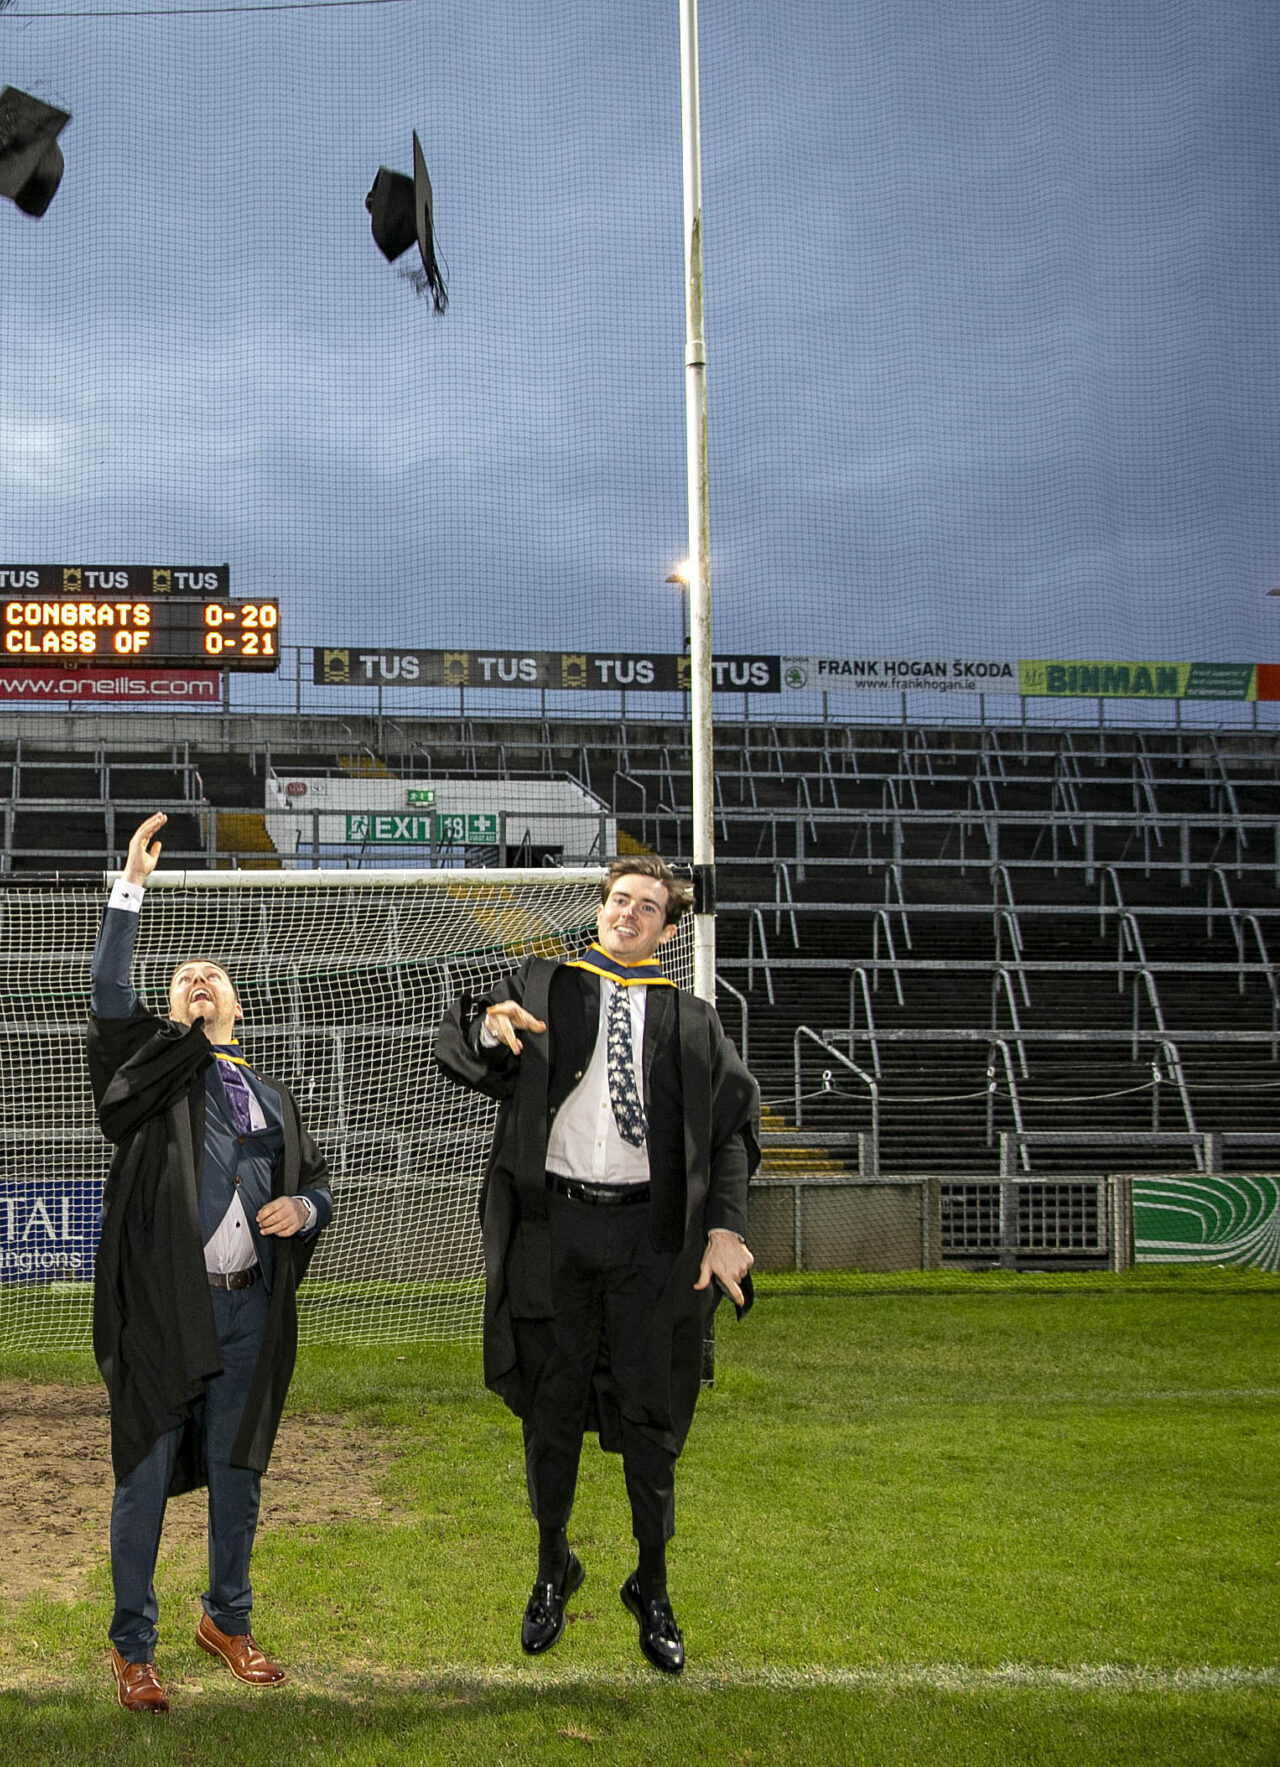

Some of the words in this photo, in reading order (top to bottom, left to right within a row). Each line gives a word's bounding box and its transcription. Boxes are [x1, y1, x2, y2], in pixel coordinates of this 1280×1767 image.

[84, 571, 129, 589] TUS
[174, 572, 219, 590] TUS
[5, 603, 151, 626] CONGRATS
[205, 604, 278, 627] 0-20
[5, 630, 96, 653] CLASS
[115, 630, 150, 653] OF
[205, 632, 275, 655] 0-21
[359, 655, 420, 680] TUS
[477, 657, 538, 682] TUS
[594, 660, 655, 684] TUS
[712, 661, 770, 686] TUS
[818, 661, 879, 676] FRANK
[884, 661, 947, 676] HOGAN
[953, 659, 1013, 678] ŠKODA
[1045, 665, 1178, 694] BINMAN
[855, 678, 976, 692] www.frankhogan.ie
[375, 816, 431, 839] EXIT
[444, 816, 464, 839] 18
